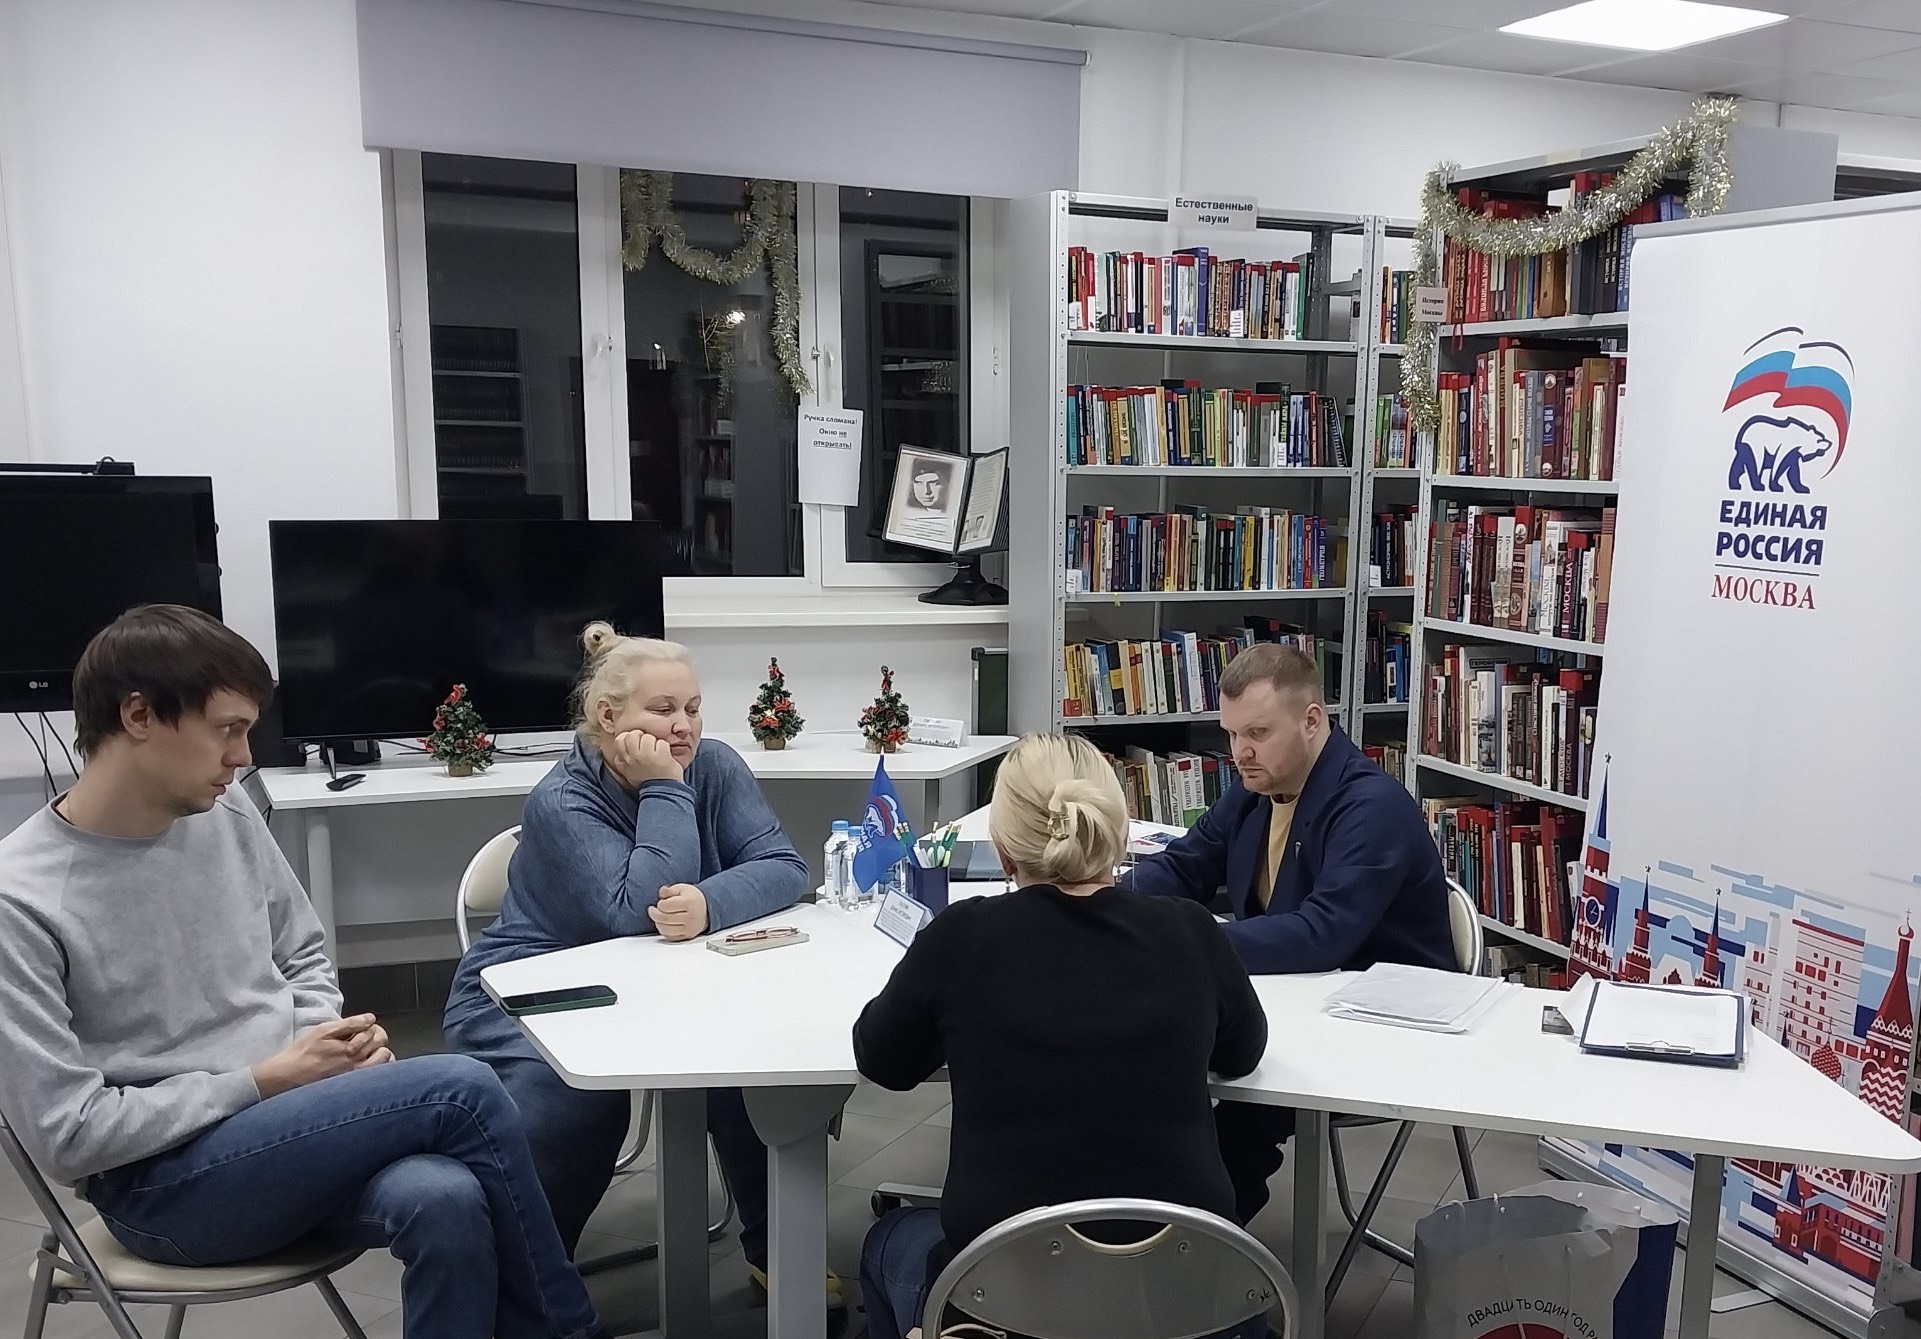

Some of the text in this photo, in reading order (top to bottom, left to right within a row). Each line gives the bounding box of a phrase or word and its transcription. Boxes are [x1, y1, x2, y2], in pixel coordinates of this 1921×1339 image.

[1175, 197, 1253, 212] Естественные
[1198, 214, 1230, 226] науки
[804, 413, 858, 425] Ручка сломана!
[819, 428, 838, 436] Окно
[813, 440, 852, 450] открывать!
[1719, 500, 1828, 530] ЕДИНАЯ
[1715, 531, 1824, 566] РОССИЯ
[1562, 562, 1573, 613] МОСКВА
[1711, 574, 1816, 610] МОСКВА
[1534, 1299, 1570, 1319] ОДИН
